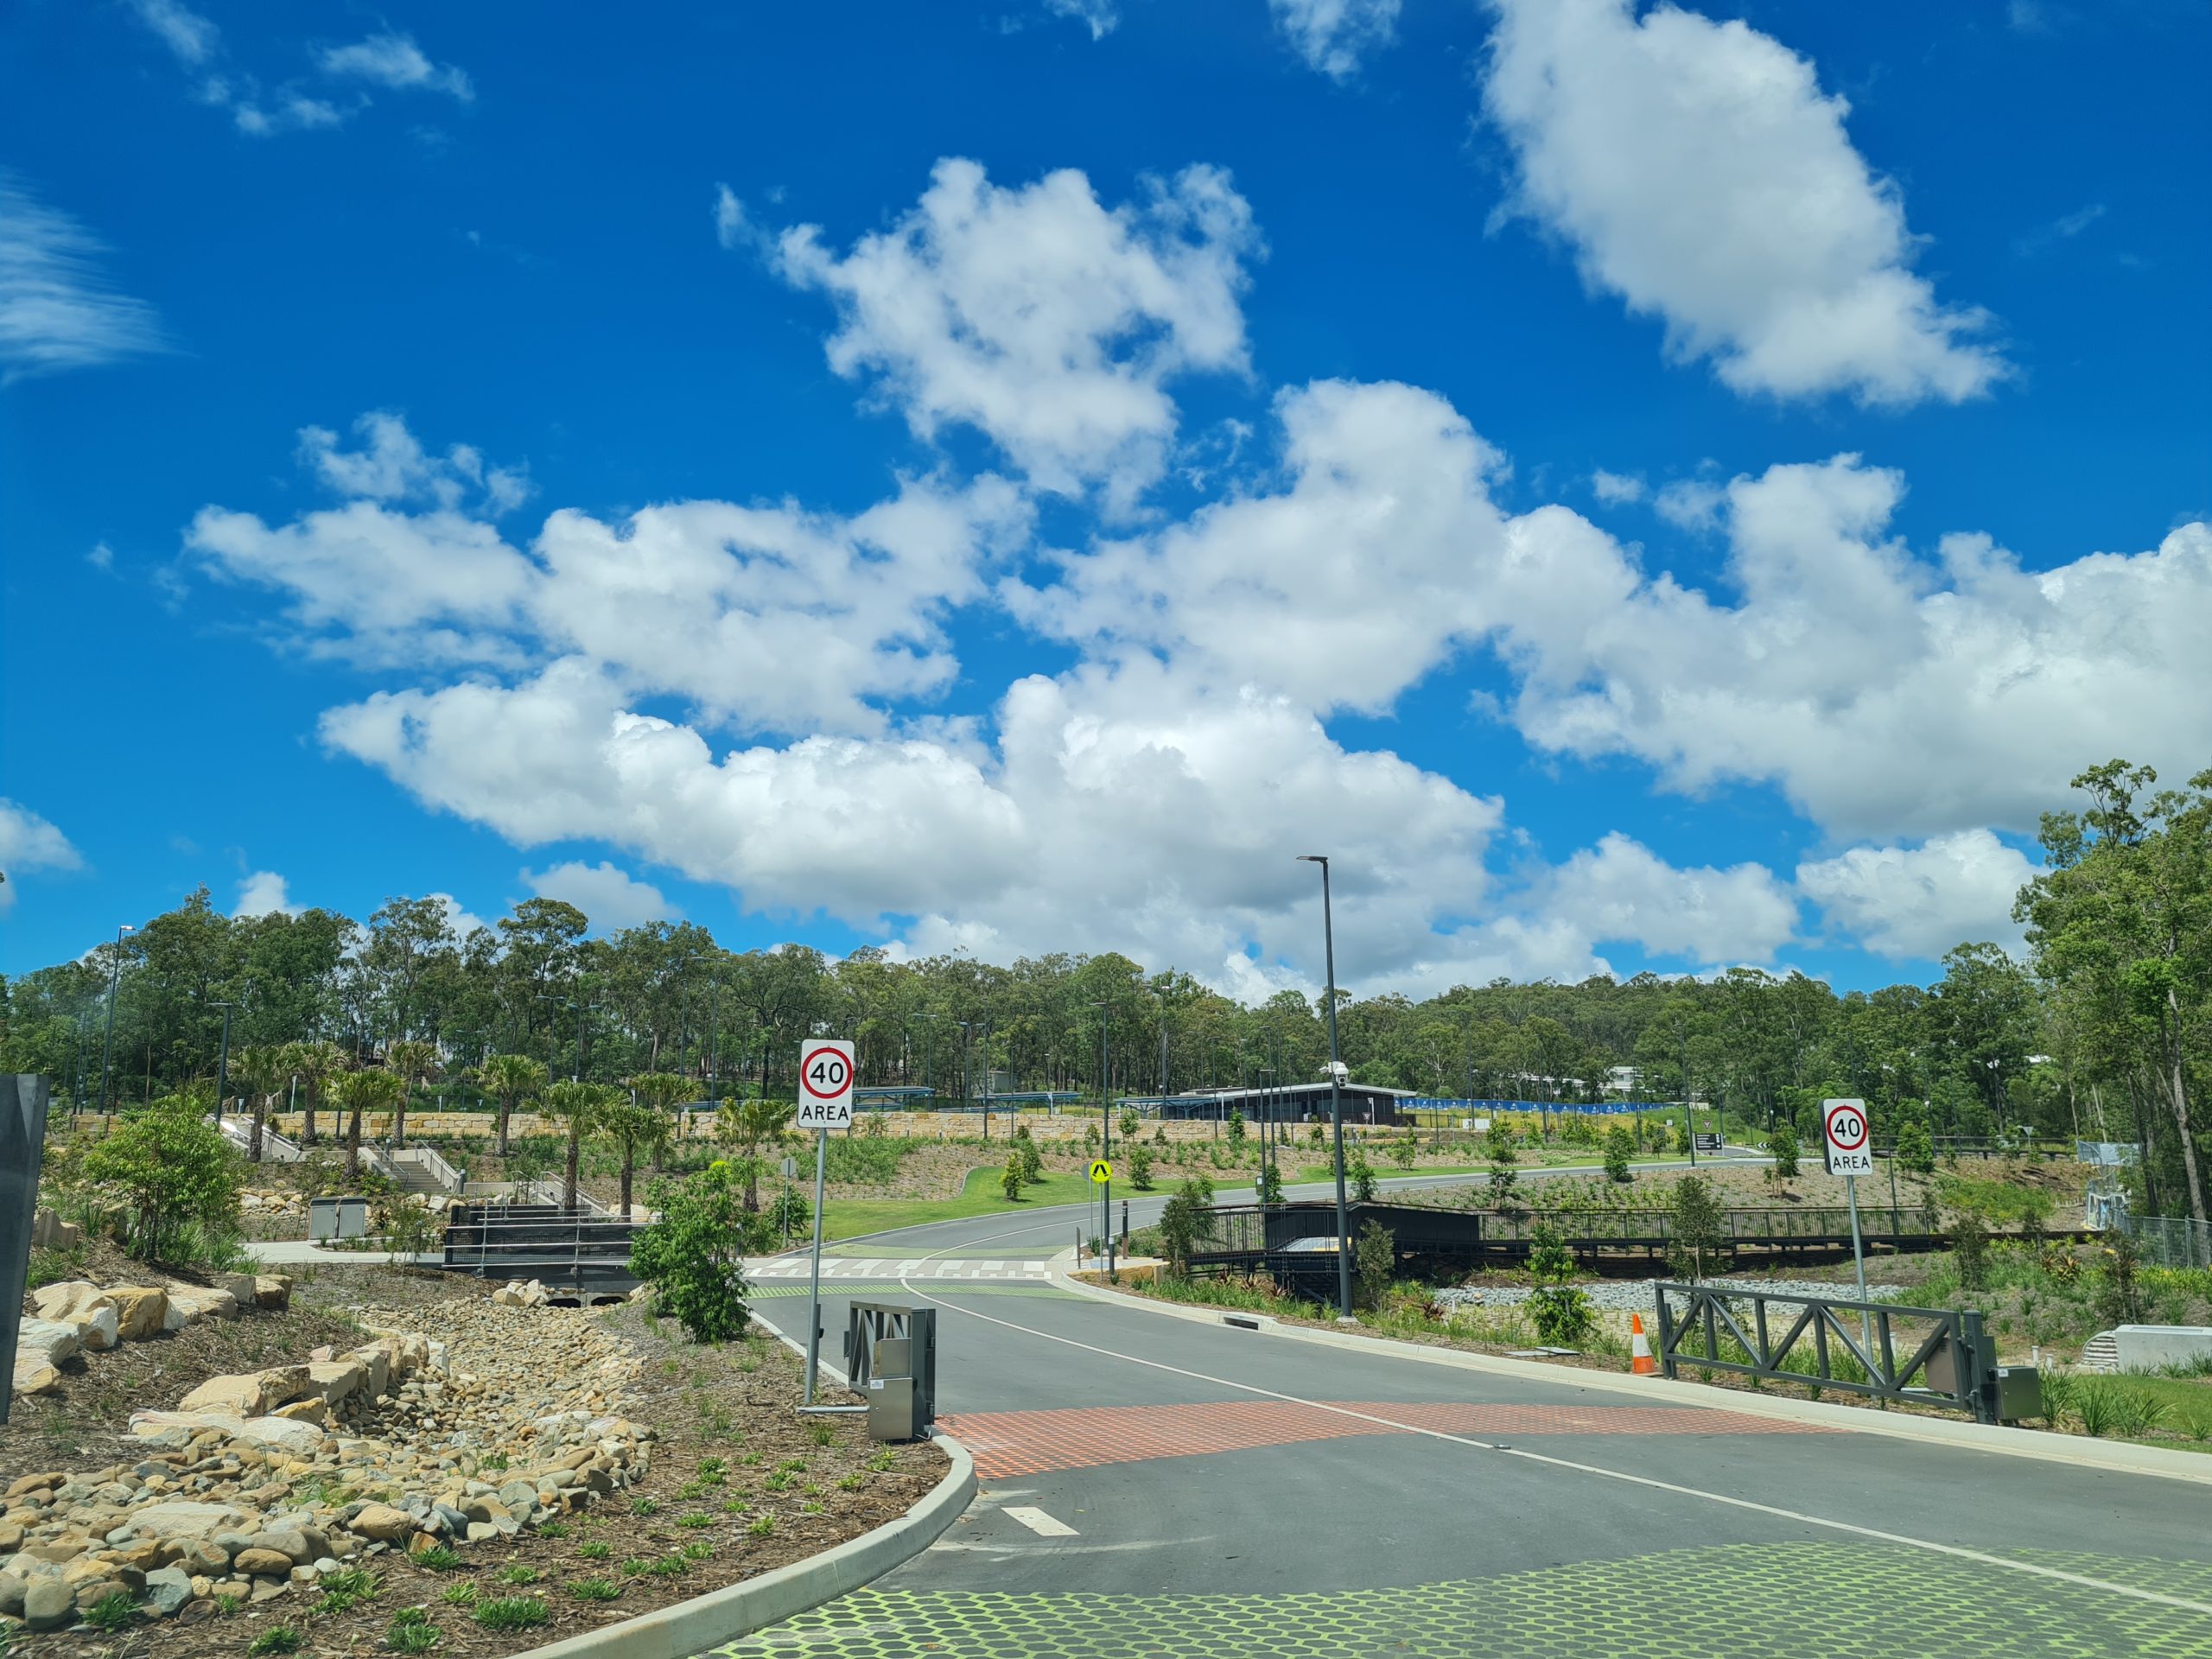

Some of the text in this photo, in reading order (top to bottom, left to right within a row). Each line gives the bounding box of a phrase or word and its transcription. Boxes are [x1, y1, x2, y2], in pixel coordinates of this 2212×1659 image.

[810, 1062, 844, 1084] 40
[801, 1105, 849, 1121] AREA
[1834, 1118, 1860, 1137] 40
[1833, 1155, 1871, 1169] AREA
